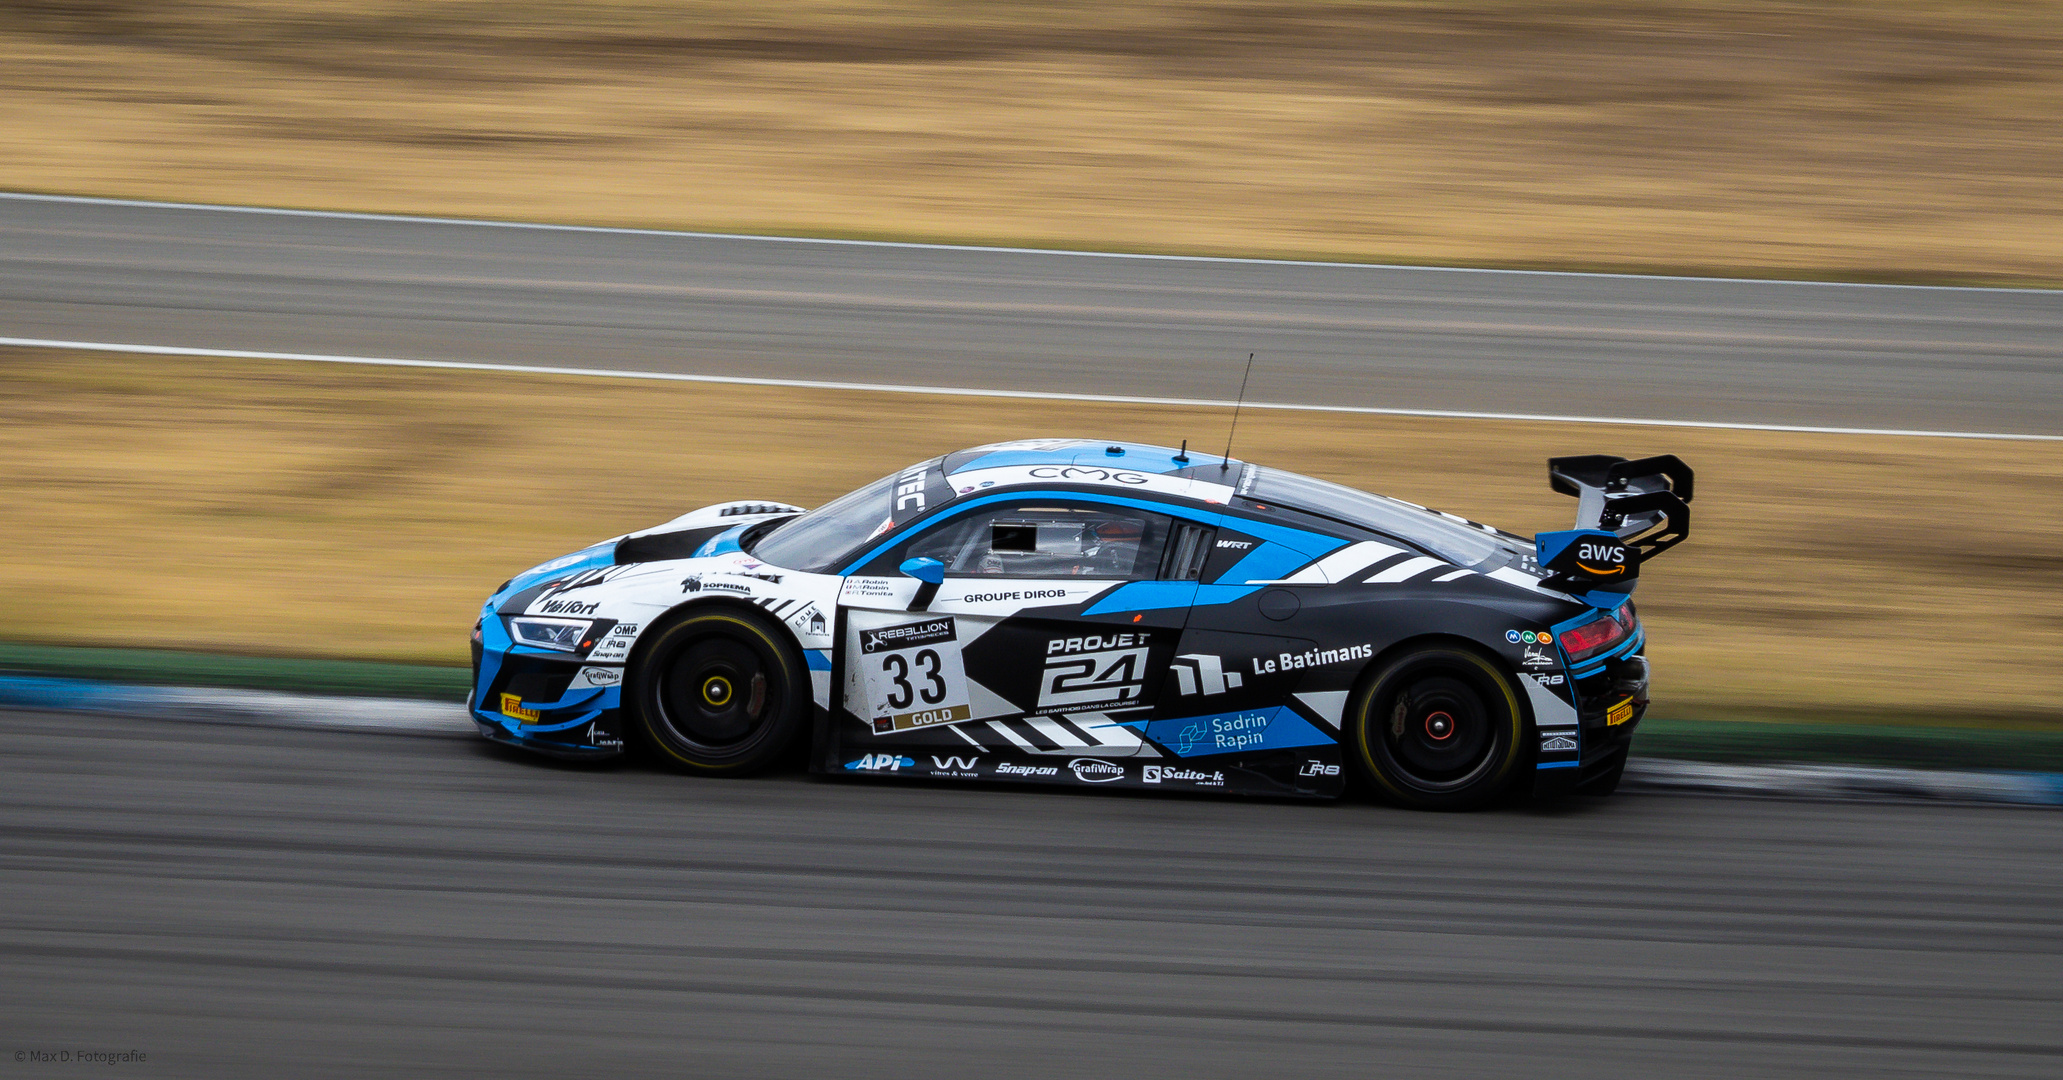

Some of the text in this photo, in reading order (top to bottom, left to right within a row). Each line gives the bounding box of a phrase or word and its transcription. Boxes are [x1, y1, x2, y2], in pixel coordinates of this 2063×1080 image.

[1028, 467, 1149, 485] CMG
[1216, 539, 1253, 549] WRT
[1578, 543, 1626, 563] aws
[702, 582, 751, 593] SOPREMA
[964, 589, 1066, 603] GROUPE DIROB
[614, 625, 638, 635] OMP
[1047, 632, 1152, 655] PROJET
[1252, 643, 1372, 676] Le Batimans
[882, 648, 947, 710] 33
[1050, 653, 1139, 701] 24
[1537, 674, 1565, 686] R8
[911, 708, 953, 726] GOLD
[1610, 702, 1632, 725] PIRELLI
[1212, 713, 1267, 733] Sadrin
[1215, 730, 1264, 750] Rapin
[995, 763, 1058, 776] Snap-on
[1073, 764, 1124, 776] GrafiWrap
[1162, 767, 1224, 781] Saito-k
[1308, 763, 1341, 775] R8
